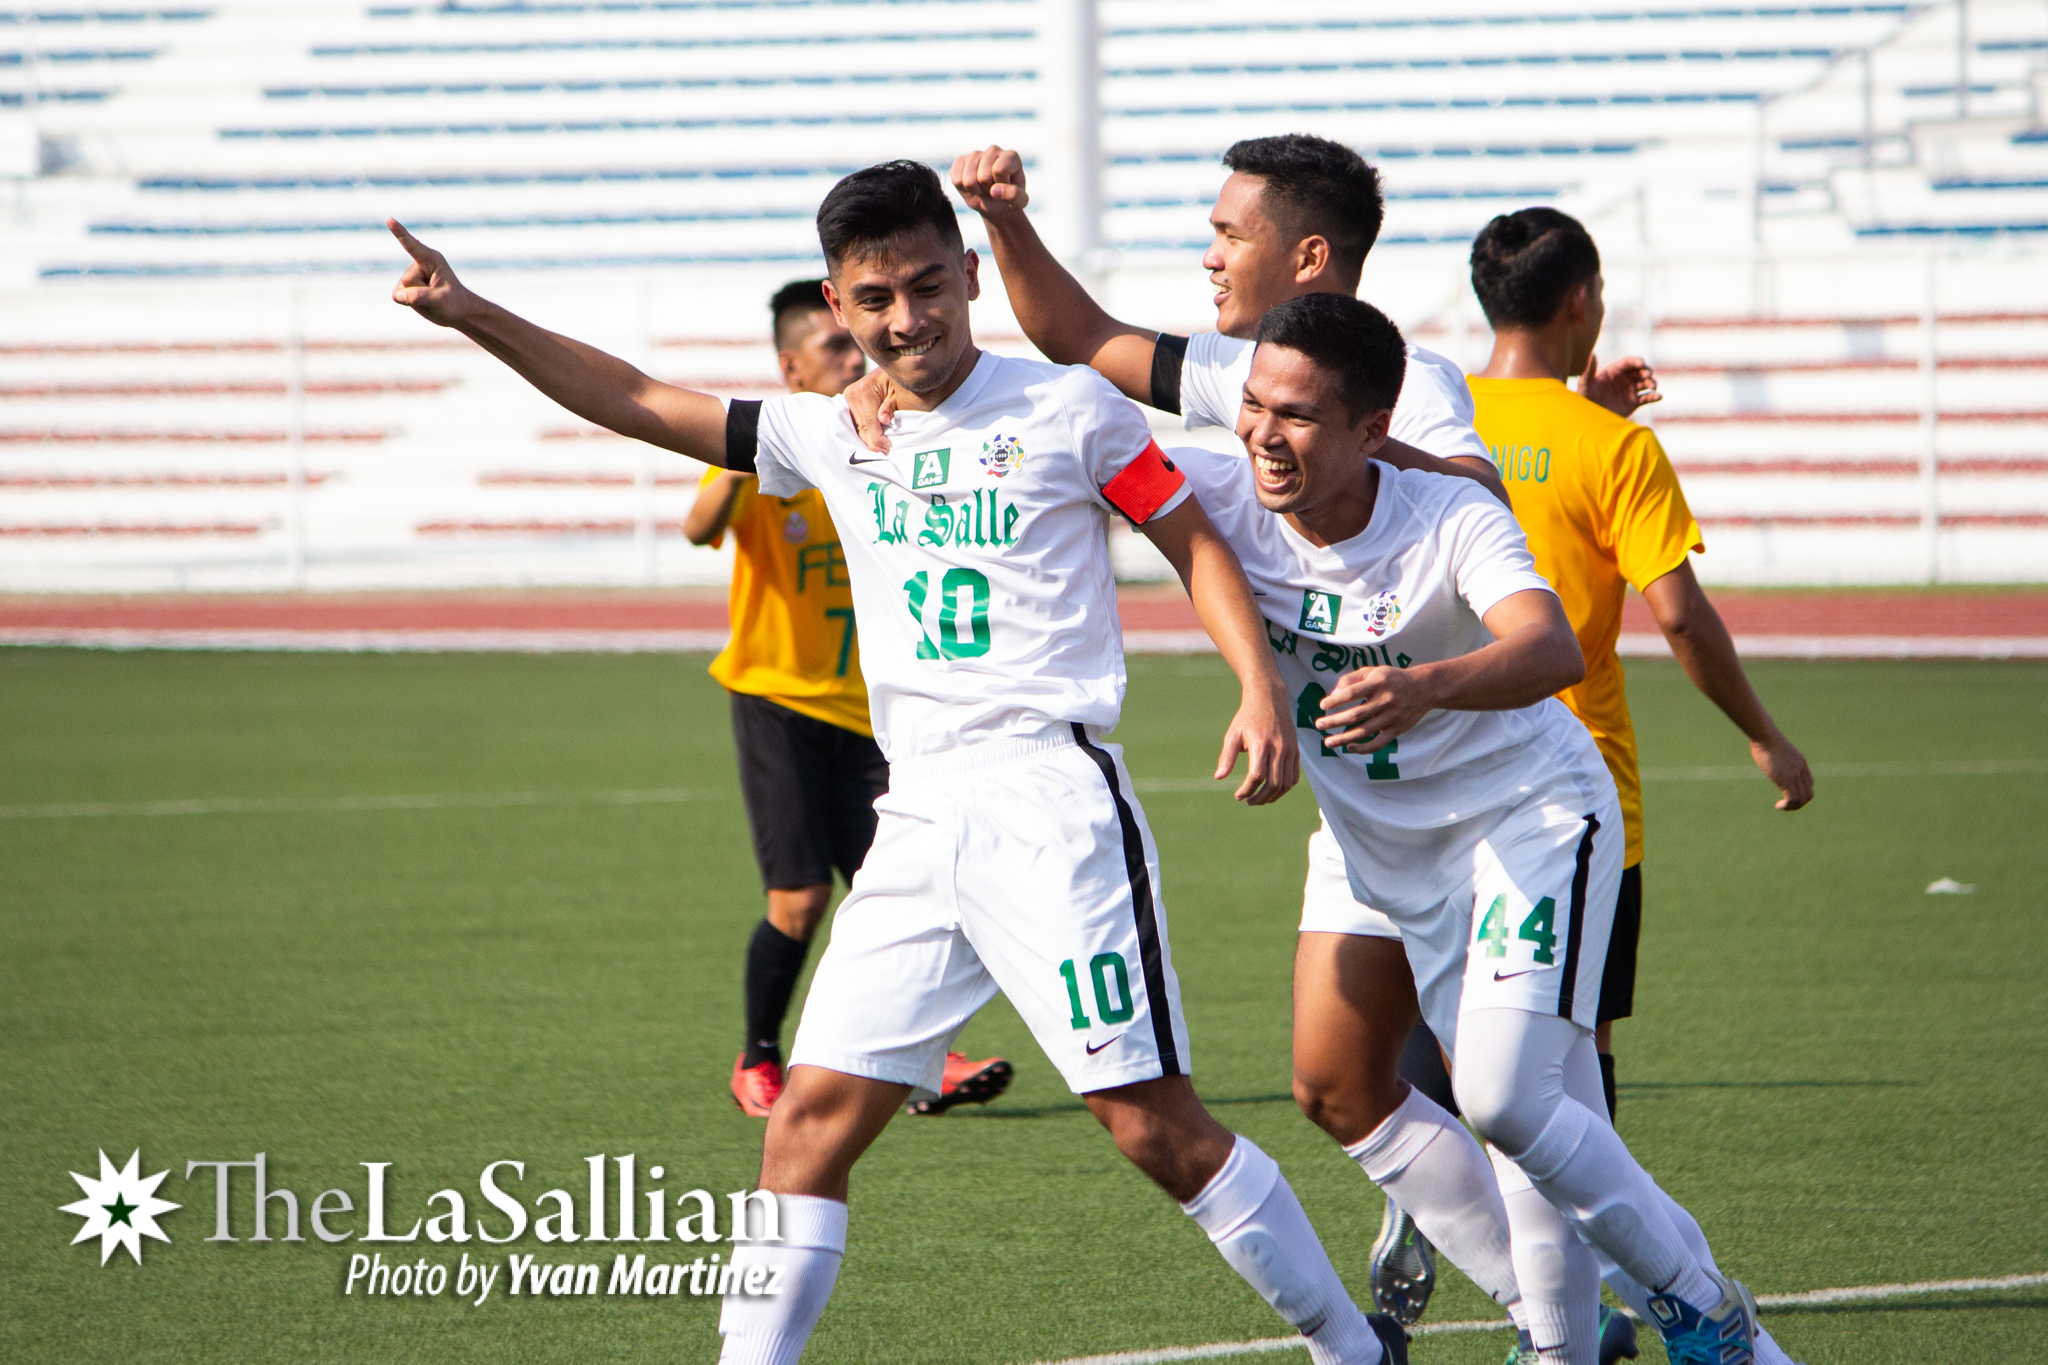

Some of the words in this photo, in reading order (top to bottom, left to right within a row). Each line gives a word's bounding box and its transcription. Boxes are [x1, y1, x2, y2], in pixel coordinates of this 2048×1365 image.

[867, 482, 911, 546] La
[917, 487, 1020, 549] Salle
[917, 475, 944, 487] GAME
[825, 607, 857, 677] 7
[903, 567, 991, 661] 10
[1305, 620, 1332, 632] GAME
[1477, 893, 1557, 966] 44
[1058, 951, 1135, 1031] 10
